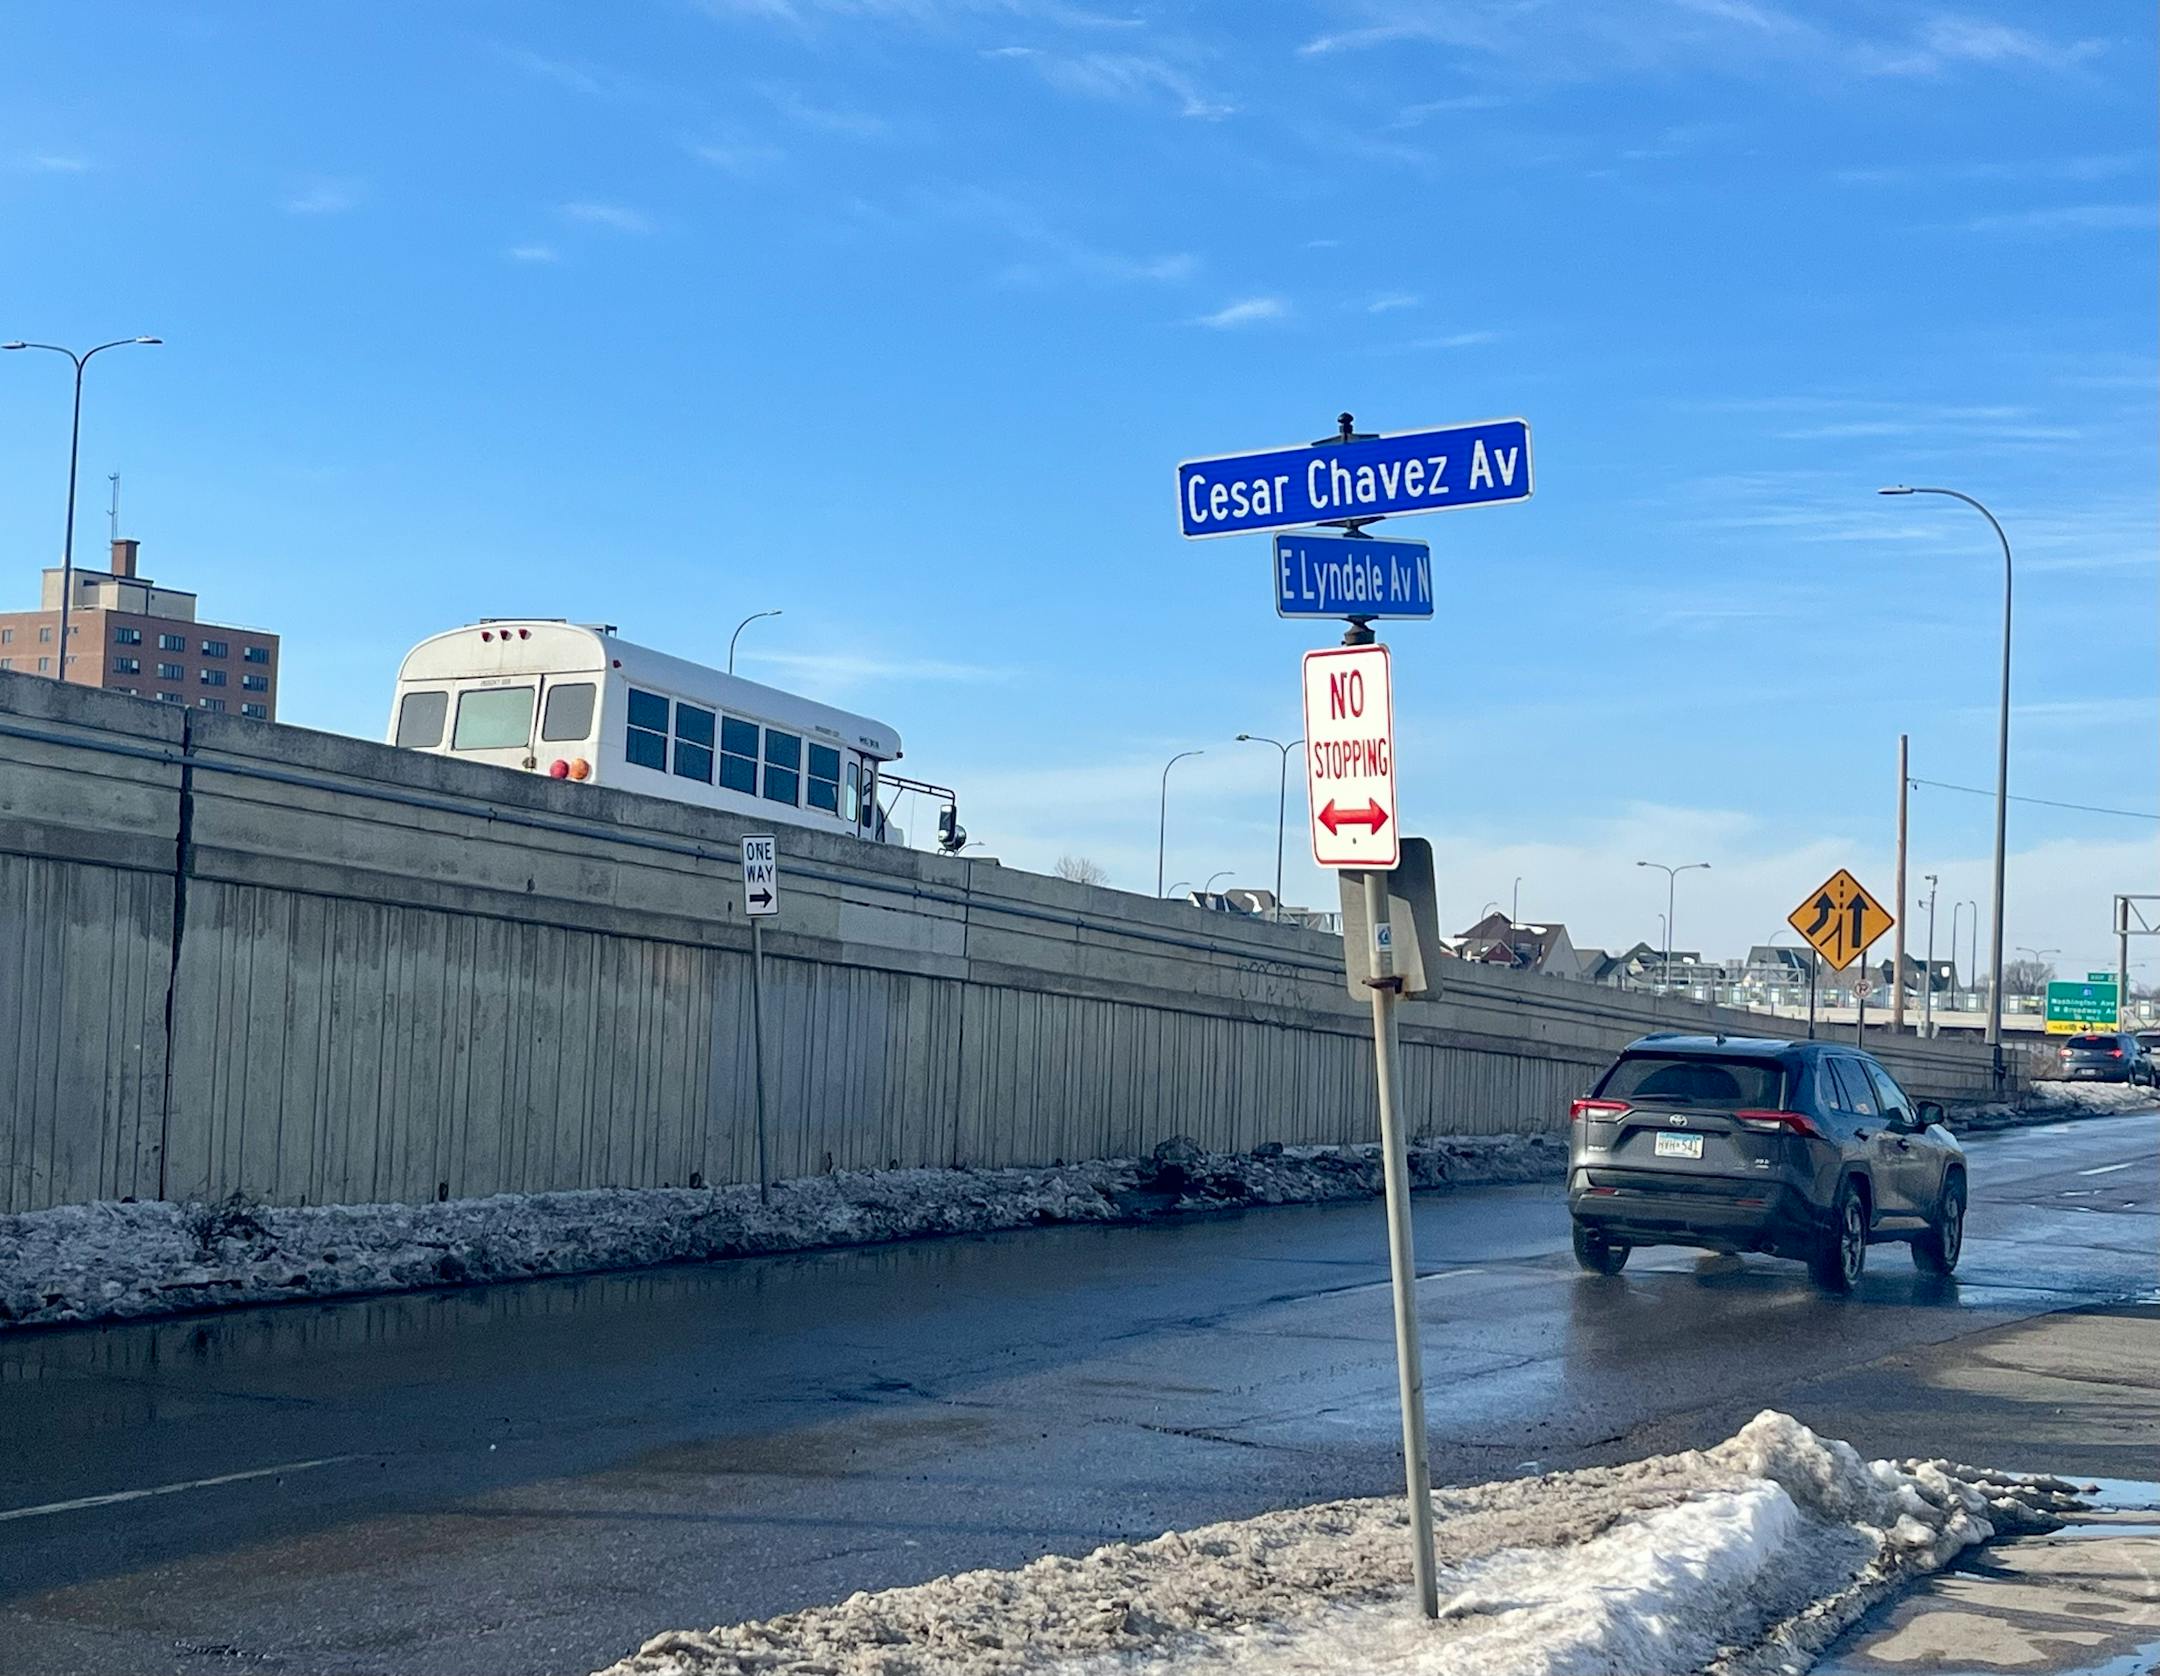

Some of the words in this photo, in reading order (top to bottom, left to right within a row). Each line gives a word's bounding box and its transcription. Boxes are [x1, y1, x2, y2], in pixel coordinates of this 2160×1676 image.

[1188, 474, 1290, 523] Cesar
[1307, 455, 1450, 509] Chavez
[1469, 439, 1519, 491] Av
[1280, 548, 1294, 600] E
[1300, 549, 1383, 610] Lyndale
[1391, 554, 1412, 603] Av
[1416, 556, 1430, 603] N
[1330, 669, 1364, 720] NO
[1314, 737, 1388, 779] STOPPING
[746, 842, 772, 861] ONE
[746, 864, 773, 883] WAY
[2051, 998, 2097, 1007] Washington
[2063, 1006, 2102, 1015] Broadway
